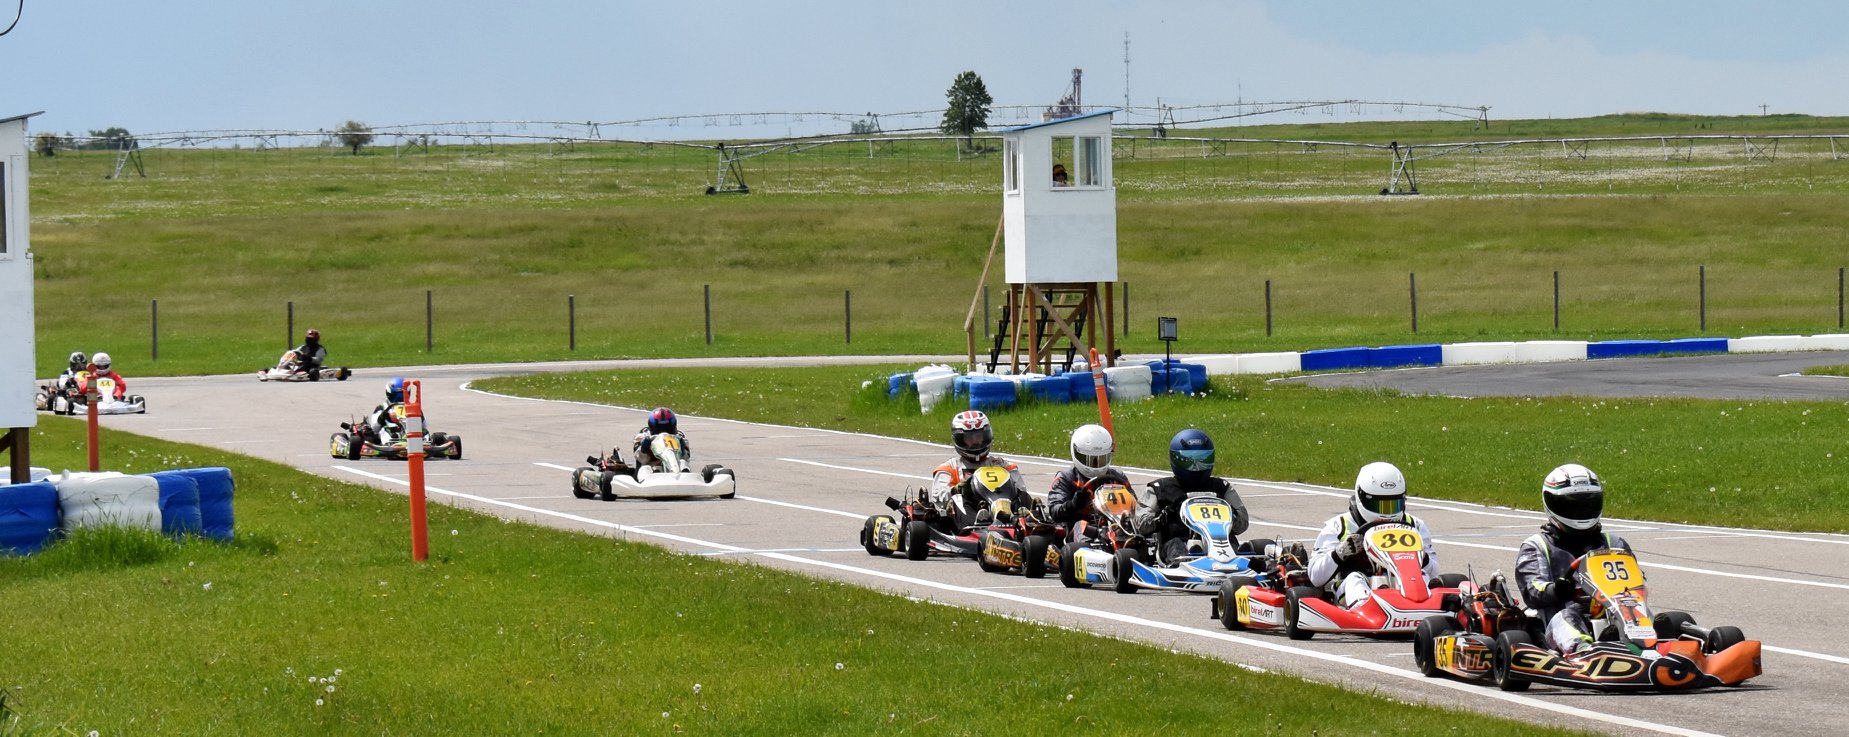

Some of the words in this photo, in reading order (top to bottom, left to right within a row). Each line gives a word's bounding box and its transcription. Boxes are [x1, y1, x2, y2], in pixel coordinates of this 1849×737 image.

[986, 471, 998, 482] 5
[1107, 492, 1126, 504] 41
[1200, 507, 1222, 519] 84
[1380, 533, 1416, 548] 30
[1602, 561, 1629, 580] 35
[1437, 638, 1448, 667] 35
